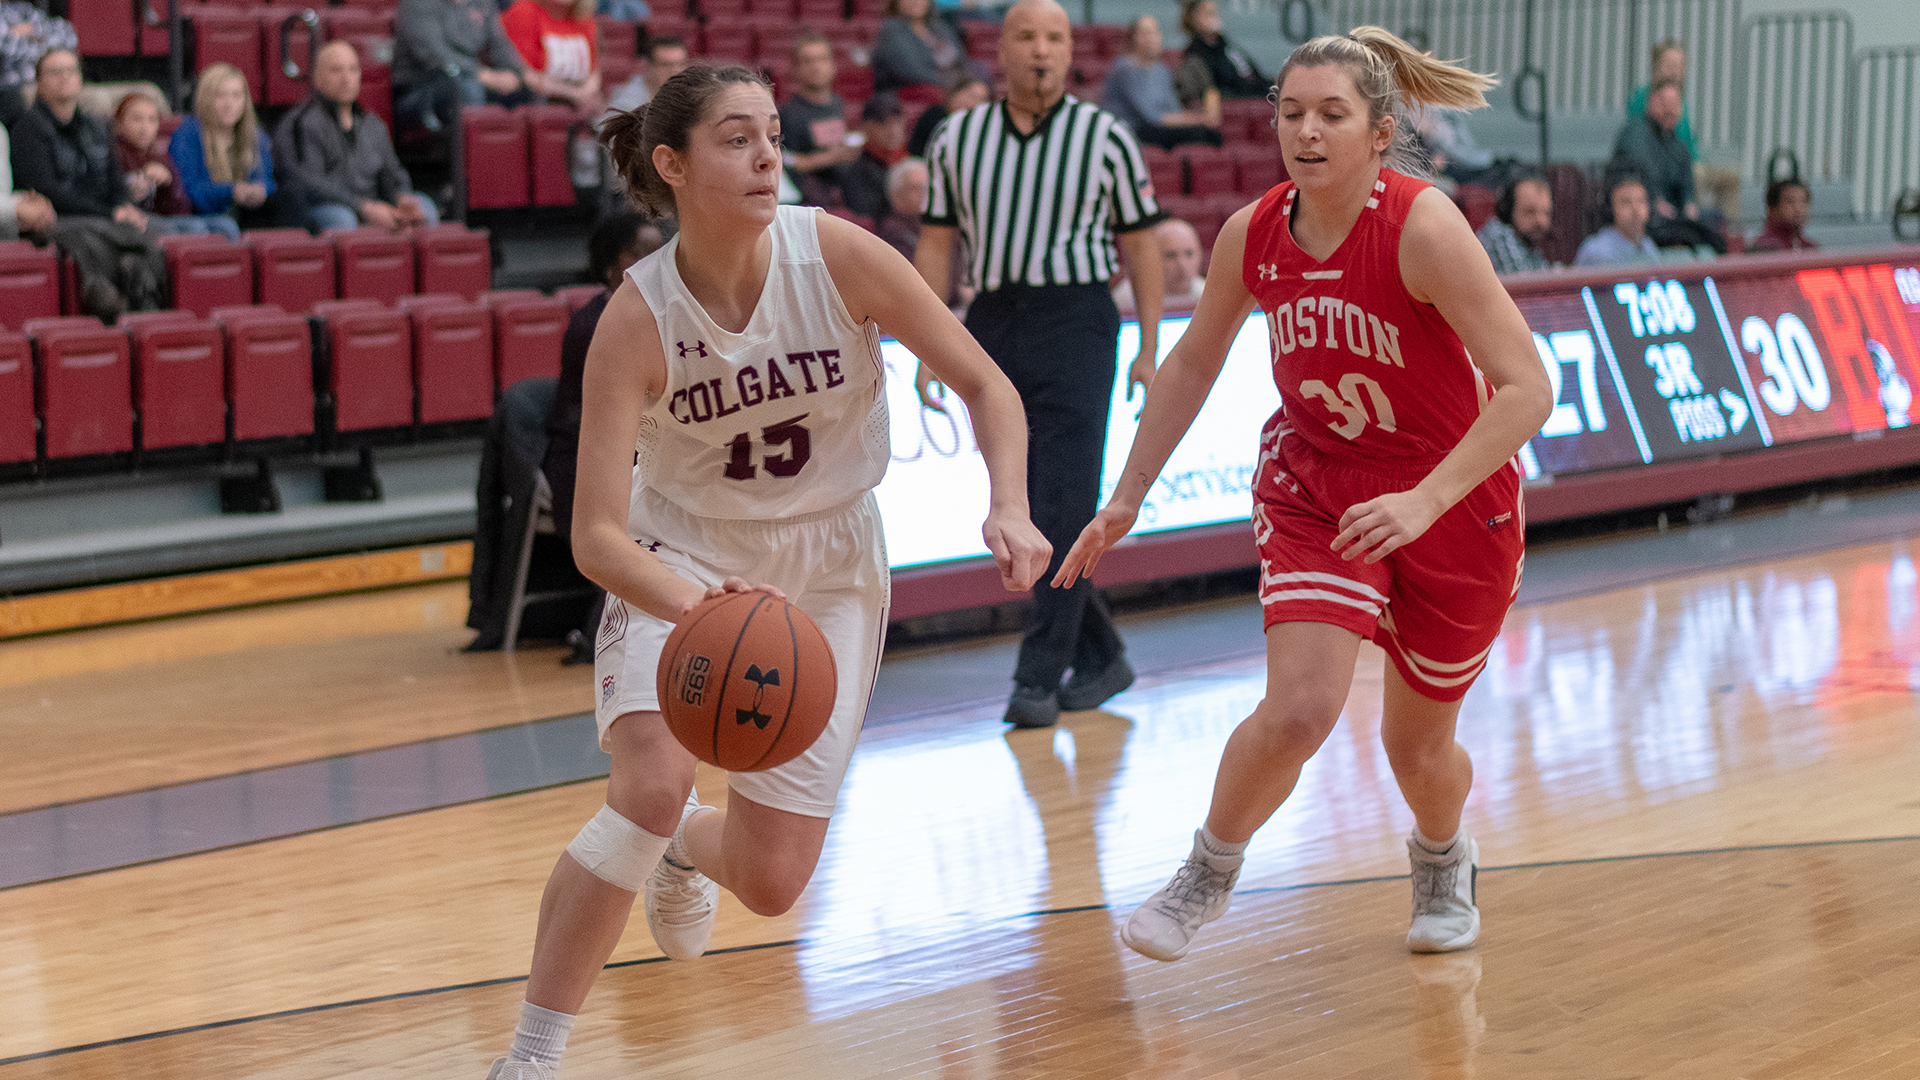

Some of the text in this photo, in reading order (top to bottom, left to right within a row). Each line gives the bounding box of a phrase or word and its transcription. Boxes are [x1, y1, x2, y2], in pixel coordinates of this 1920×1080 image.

[1613, 278, 1697, 338] 7:08
[668, 348, 845, 425] COLGATE
[1532, 329, 1608, 438] 27
[1644, 341, 1704, 399] 3R
[1741, 312, 1831, 416] 30
[1299, 373, 1397, 440] 30
[723, 412, 812, 481] 15
[685, 655, 712, 707] 695
